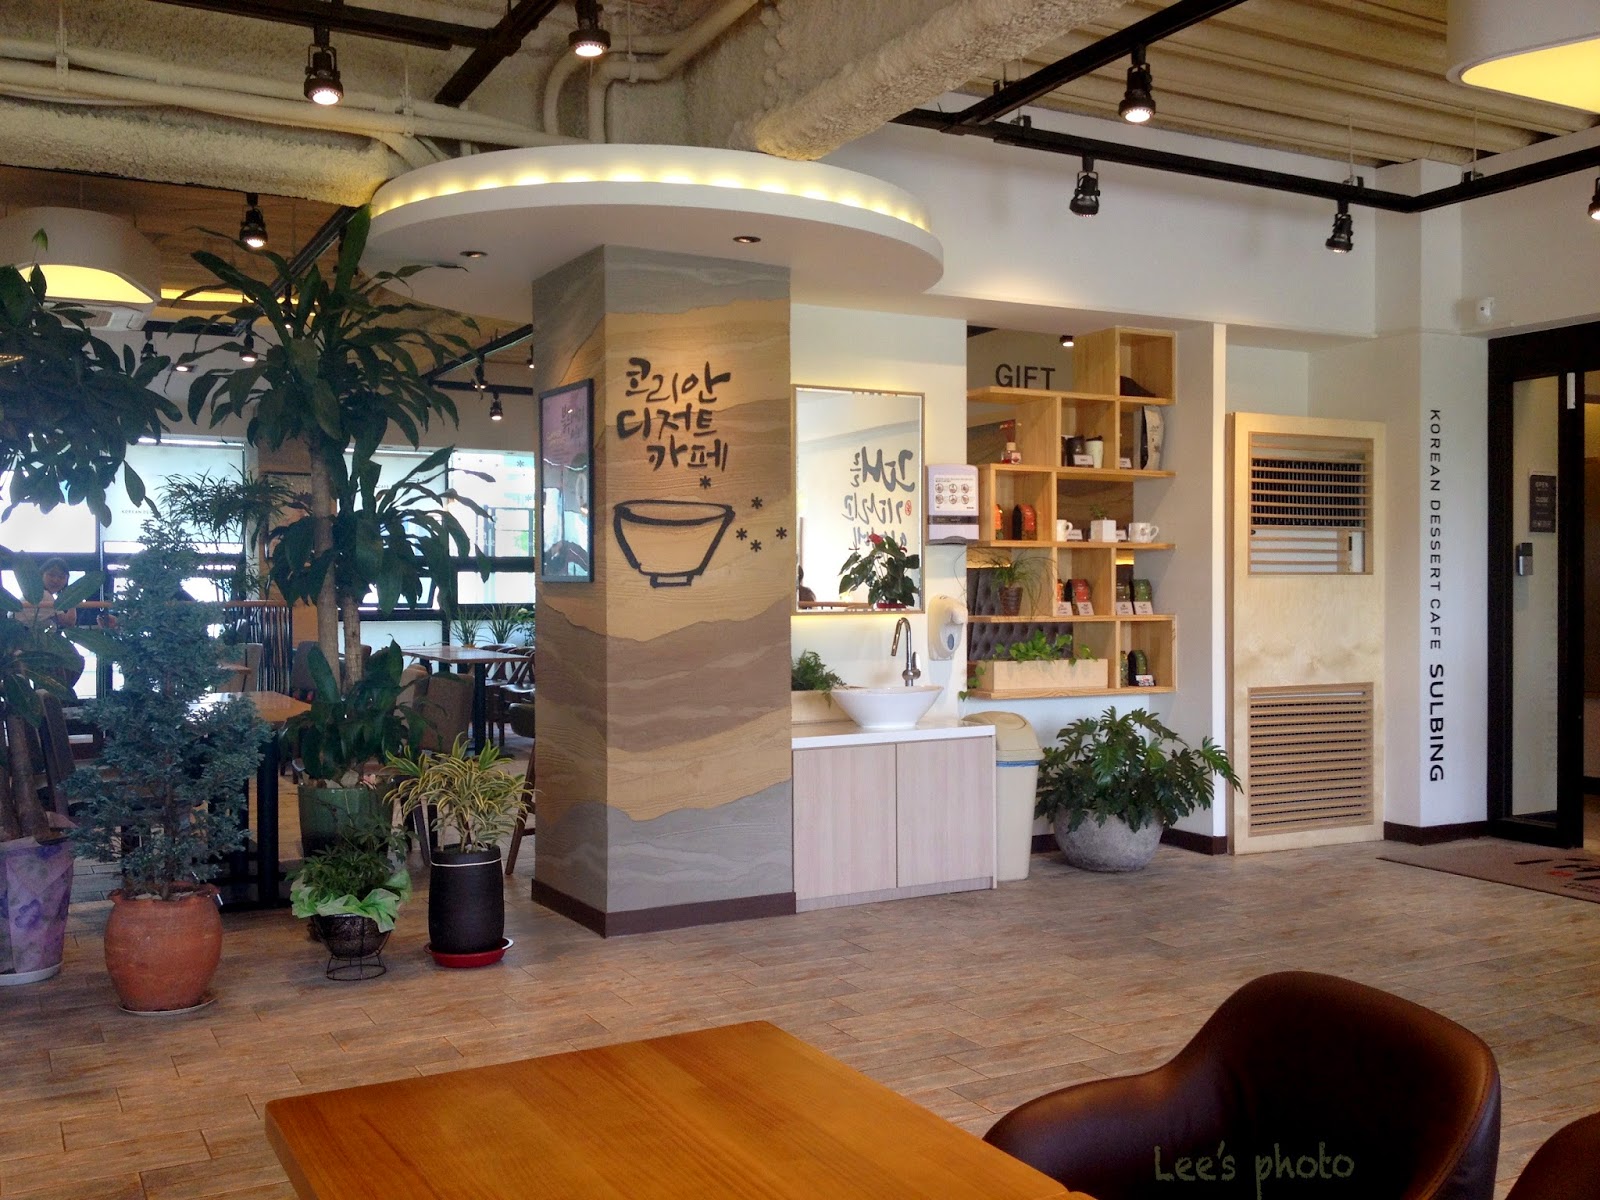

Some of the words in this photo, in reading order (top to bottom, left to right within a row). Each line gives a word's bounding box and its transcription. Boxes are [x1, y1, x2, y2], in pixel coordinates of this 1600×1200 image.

[625, 357, 731, 404] 코리안
[995, 363, 1056, 390] GIFT
[616, 403, 717, 439] 디저트
[646, 435, 728, 472] 카페
[1430, 409, 1441, 491] KOREAN
[1430, 500, 1441, 591] DESSERT
[1430, 598, 1441, 650] CAFE
[1429, 663, 1444, 782] SULBING
